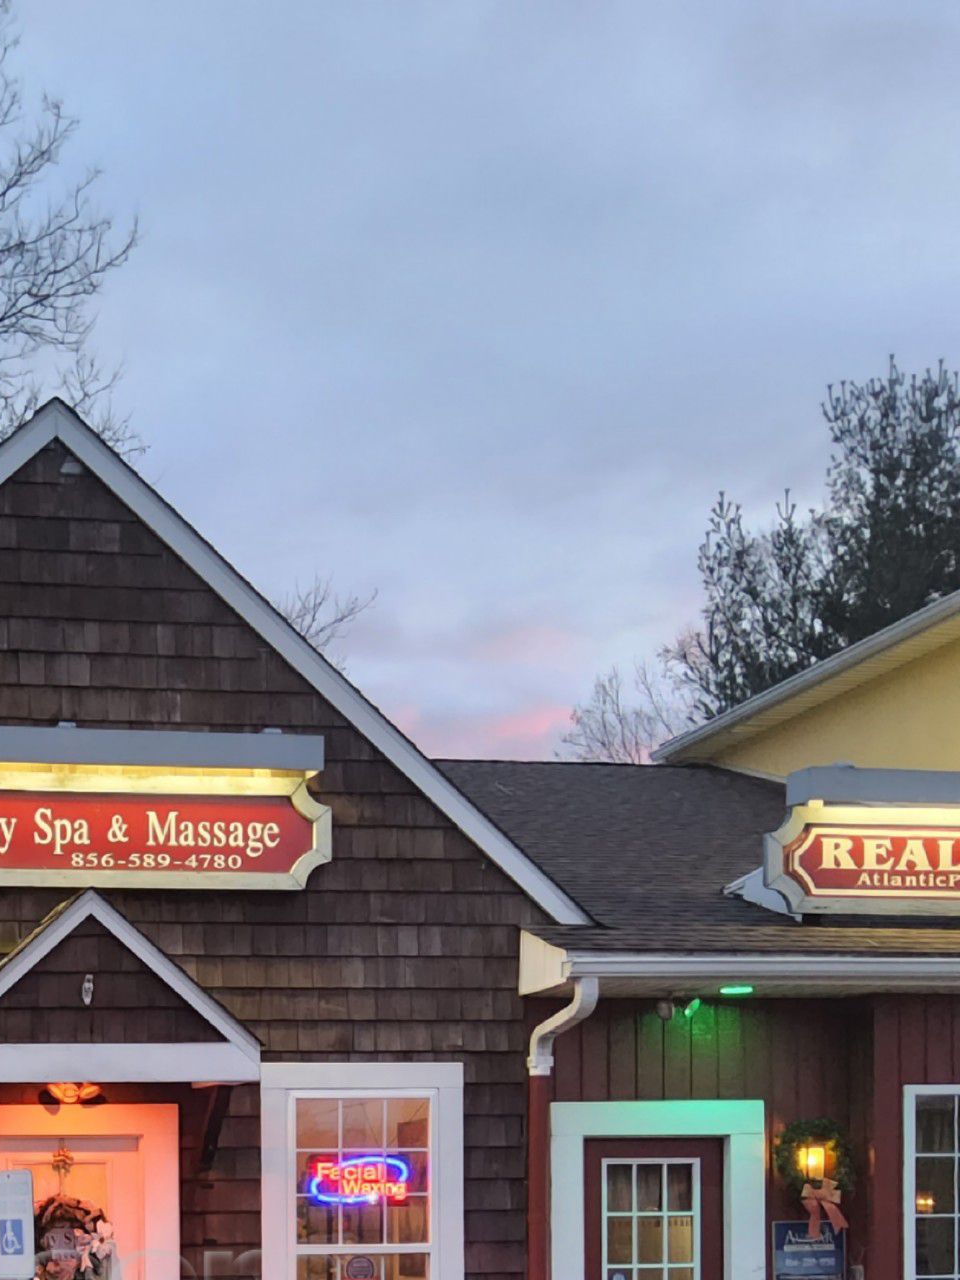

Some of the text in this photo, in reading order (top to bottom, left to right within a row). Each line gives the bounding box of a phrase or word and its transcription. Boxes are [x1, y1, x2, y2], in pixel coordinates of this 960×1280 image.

[34, 807, 90, 855] Spa
[107, 814, 129, 843] &
[146, 810, 280, 858] Massage
[71, 853, 242, 869] 856-589-4780
[817, 837, 960, 871] REAL
[316, 1161, 386, 1180] Facial
[342, 1179, 407, 1201] Waxing
